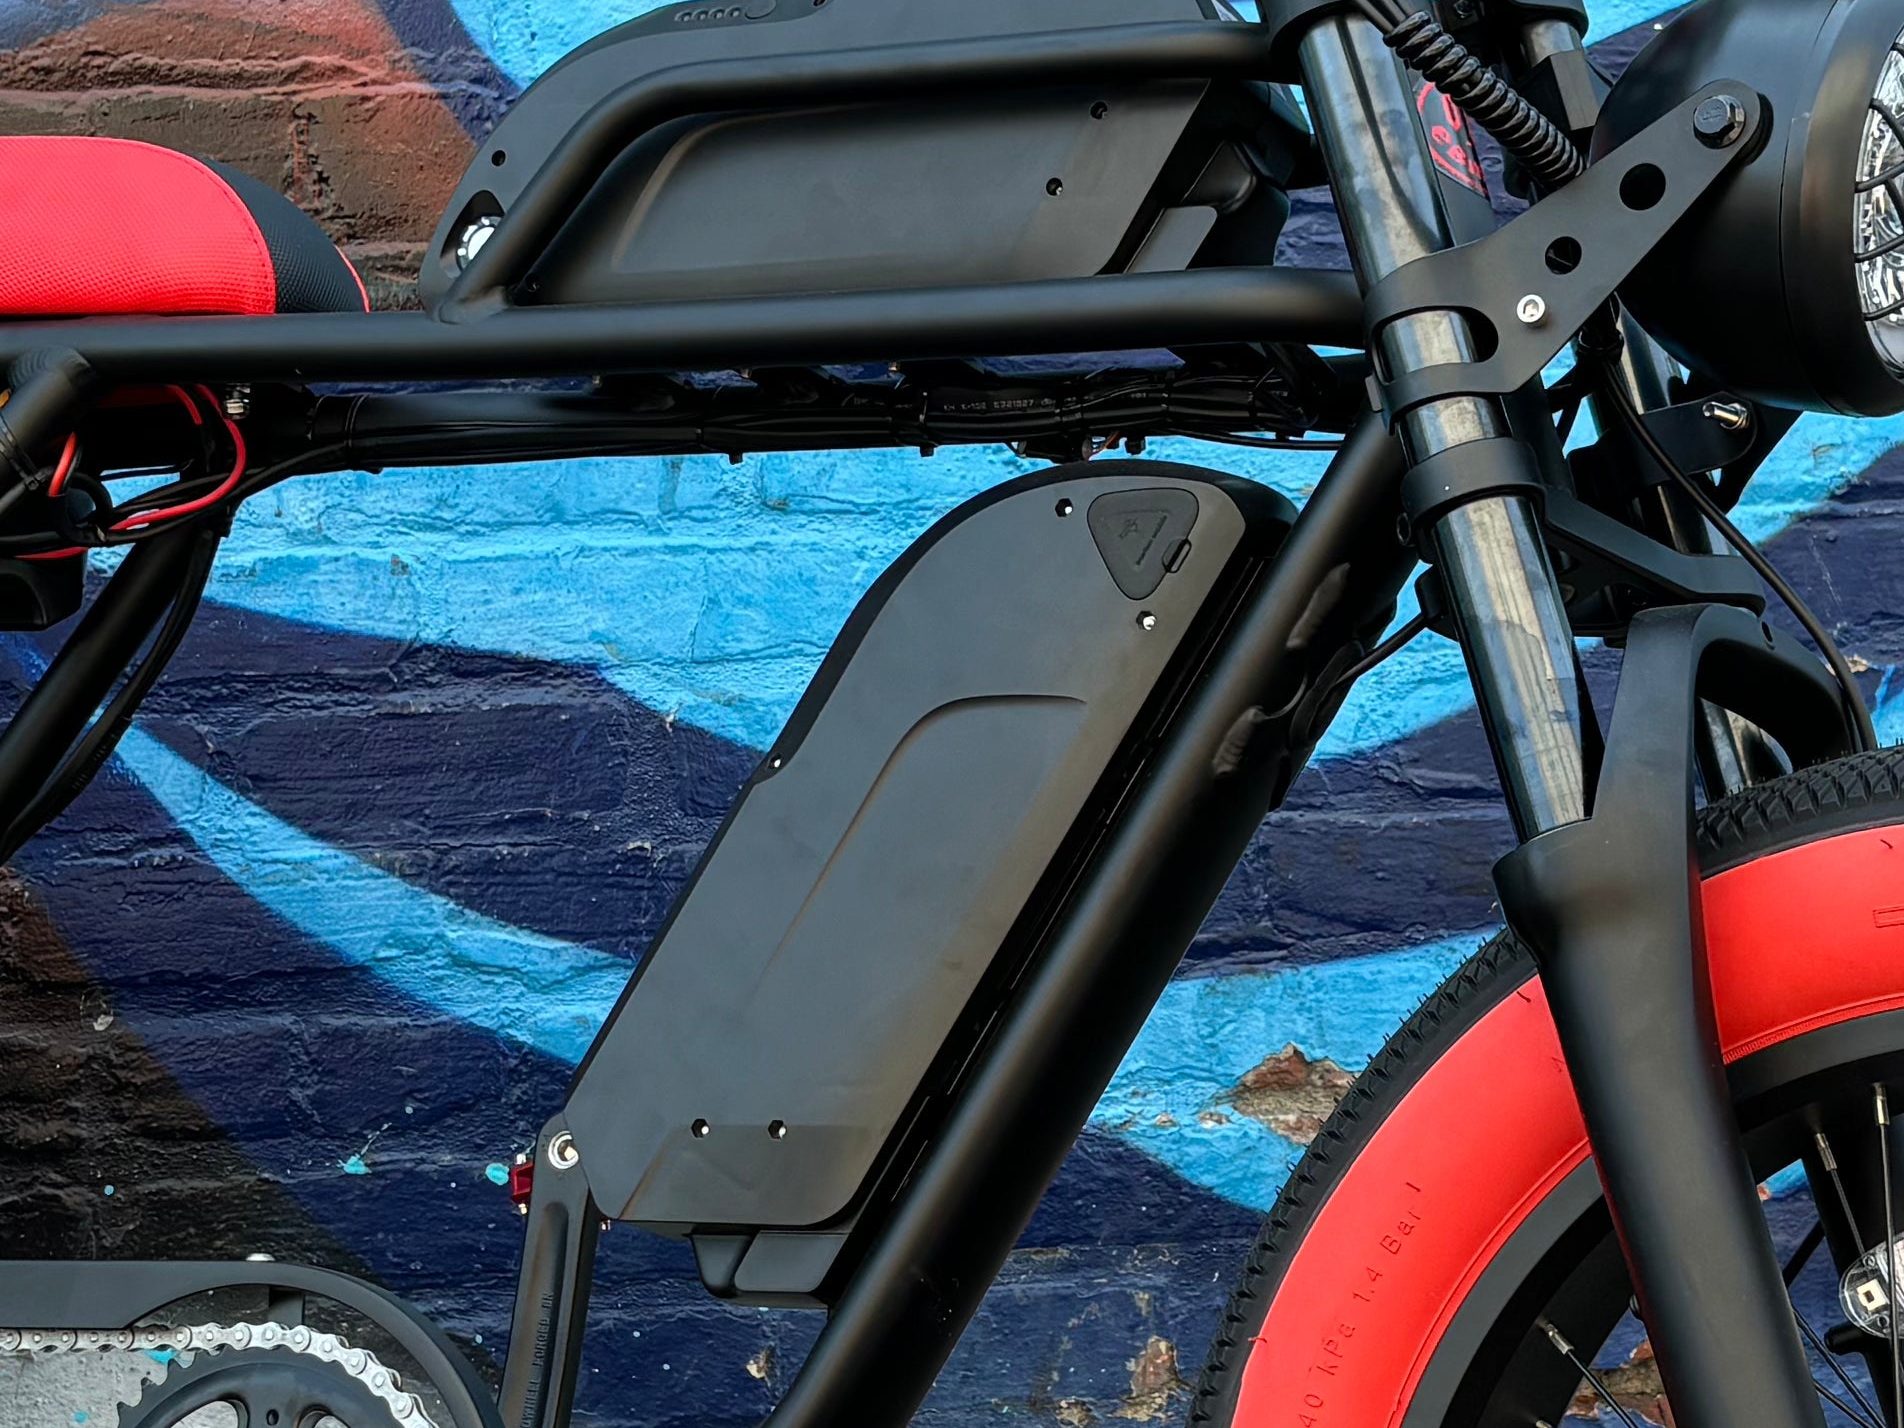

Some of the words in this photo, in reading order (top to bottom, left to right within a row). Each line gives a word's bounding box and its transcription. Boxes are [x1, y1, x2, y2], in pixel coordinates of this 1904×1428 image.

[1308, 1322, 1356, 1377] kPa
[1352, 1266, 1384, 1304] 1.4
[1379, 1210, 1422, 1256] Bar
